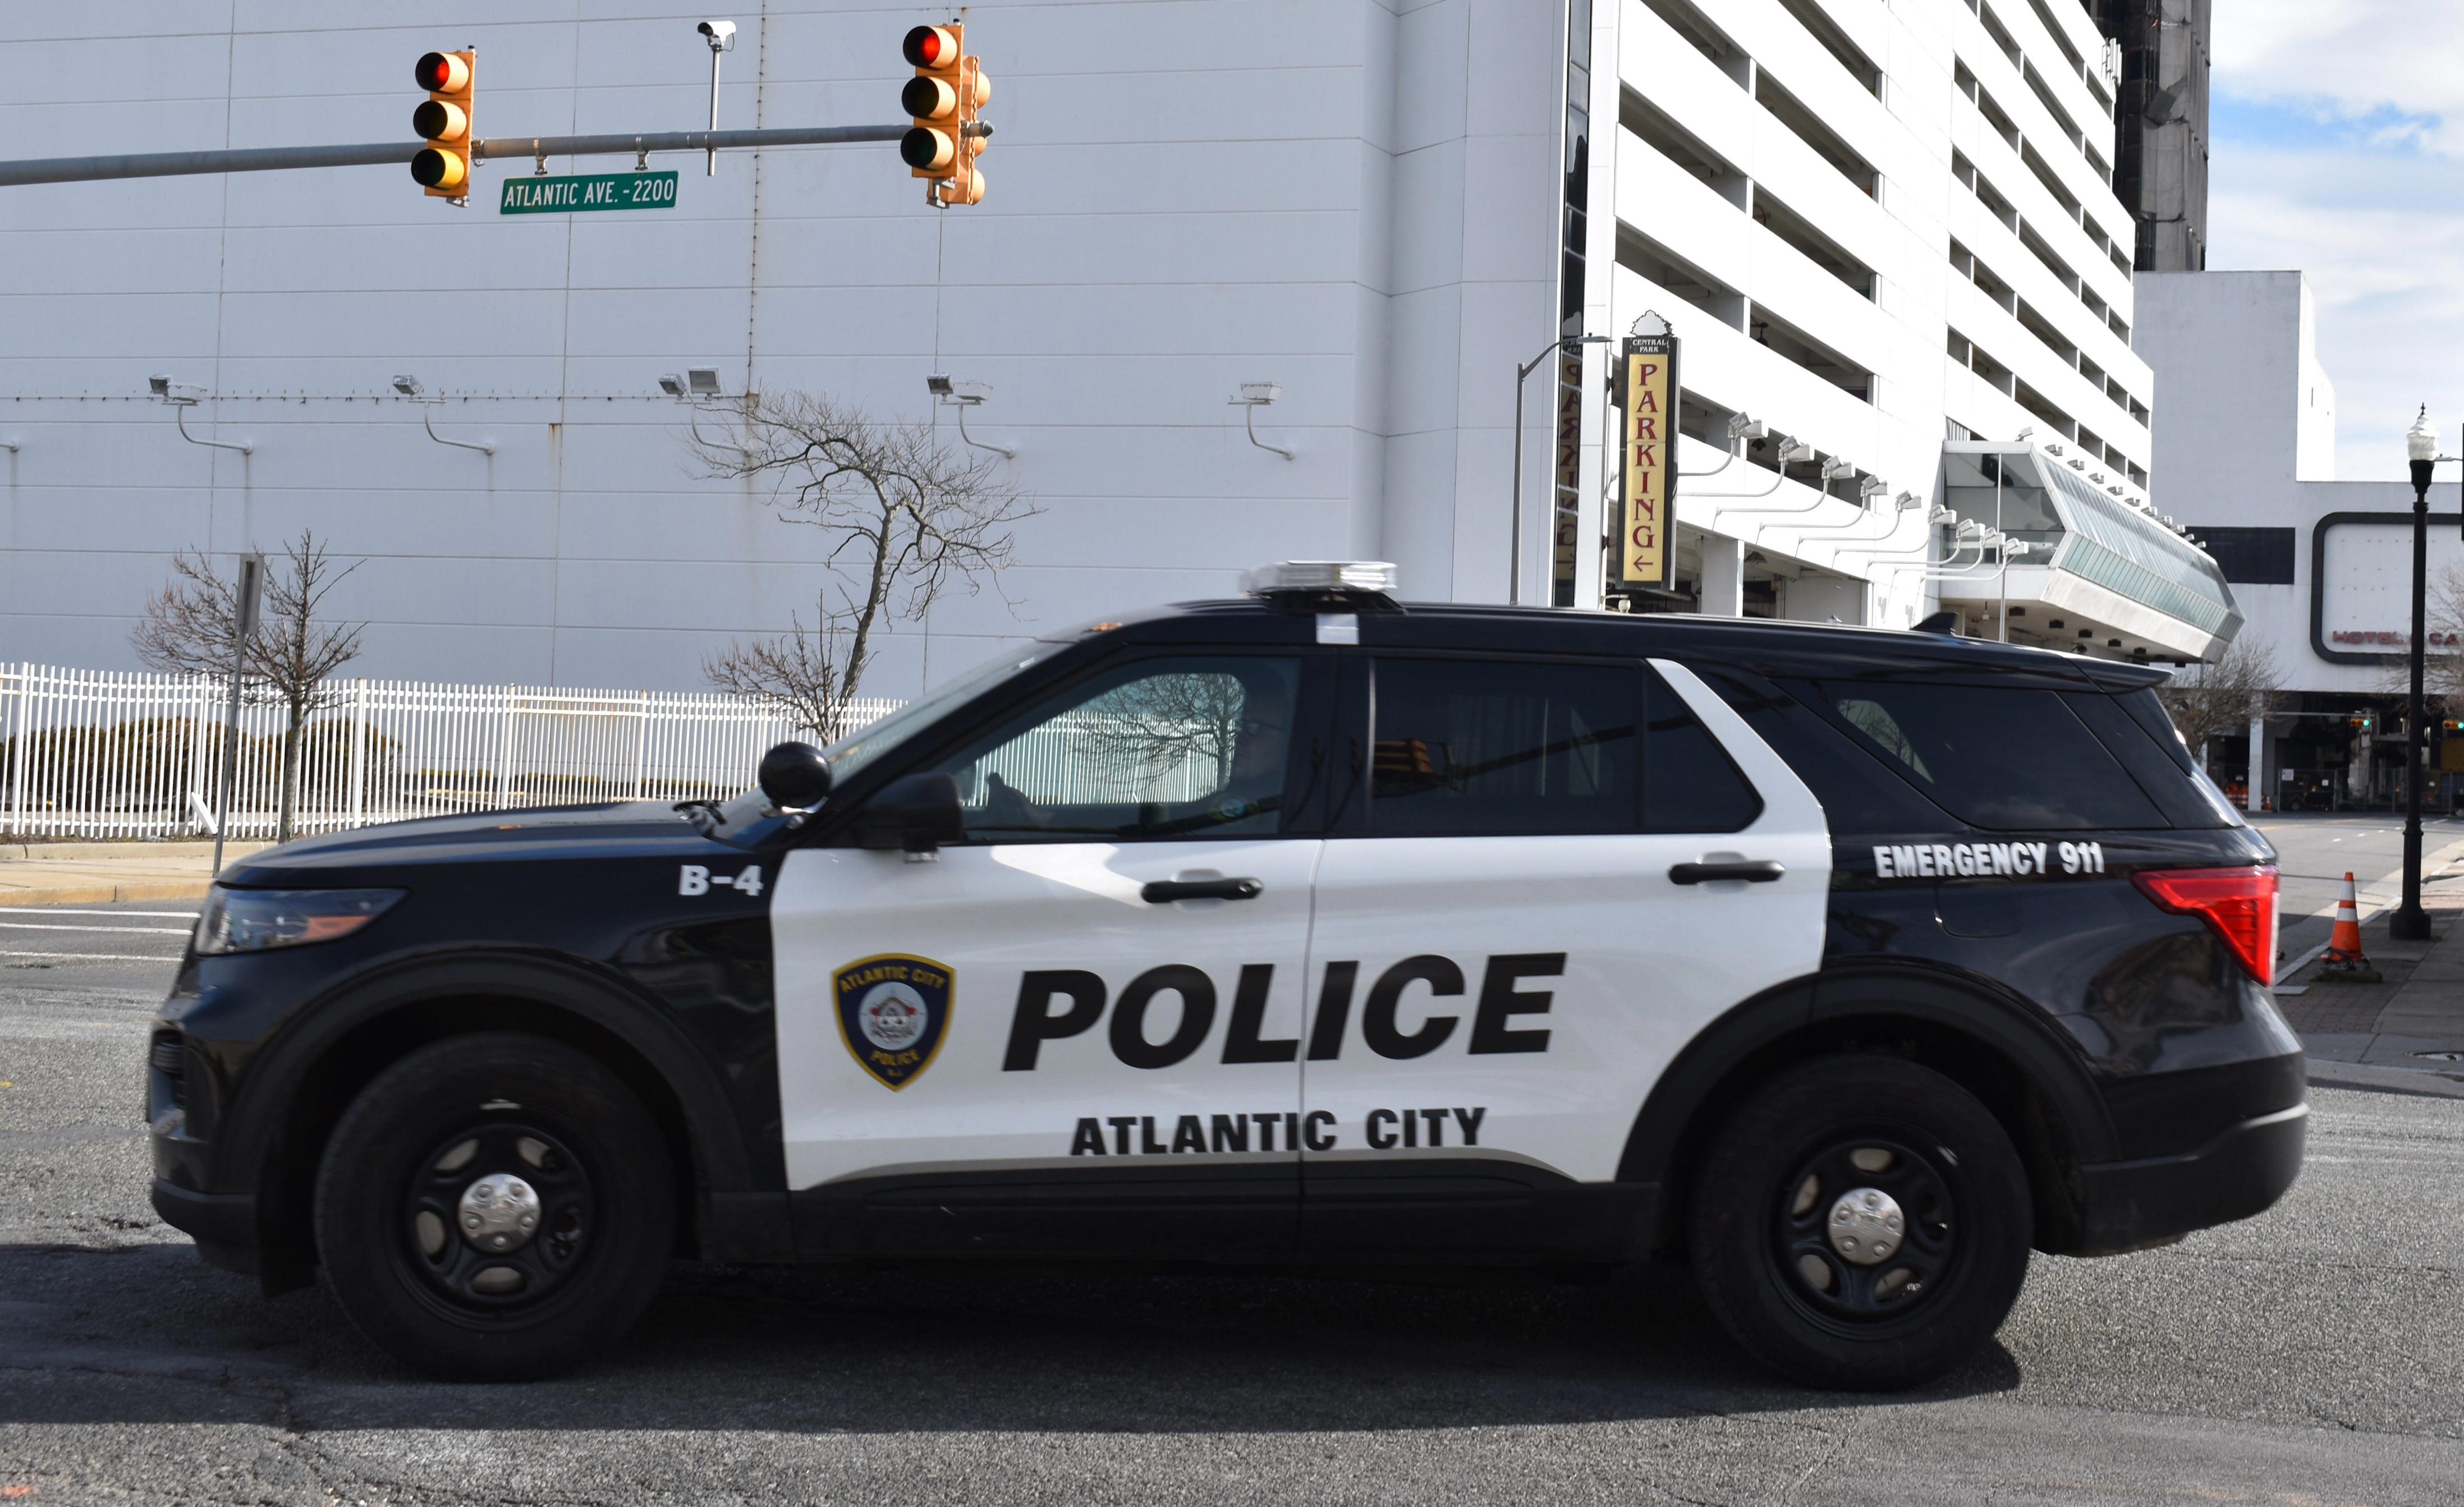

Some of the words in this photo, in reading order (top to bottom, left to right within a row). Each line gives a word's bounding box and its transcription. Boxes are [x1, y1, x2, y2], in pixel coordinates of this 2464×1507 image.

[504, 183, 578, 206] ATLANTIC
[584, 182, 618, 204] AVE.
[1632, 364, 1658, 548] PARKING
[2333, 631, 2404, 644] HOTEL
[1873, 842, 2047, 878] EMERGENCY
[2058, 841, 2105, 874] 911
[678, 865, 764, 896] B-4
[841, 966, 908, 992] ATLANTIC
[912, 970, 946, 989] CITY
[1001, 952, 1567, 1071] POLICE
[871, 1049, 921, 1066] POLICE
[1070, 1110, 1337, 1156] ATLANTIC
[1365, 1107, 1487, 1150] CITY
